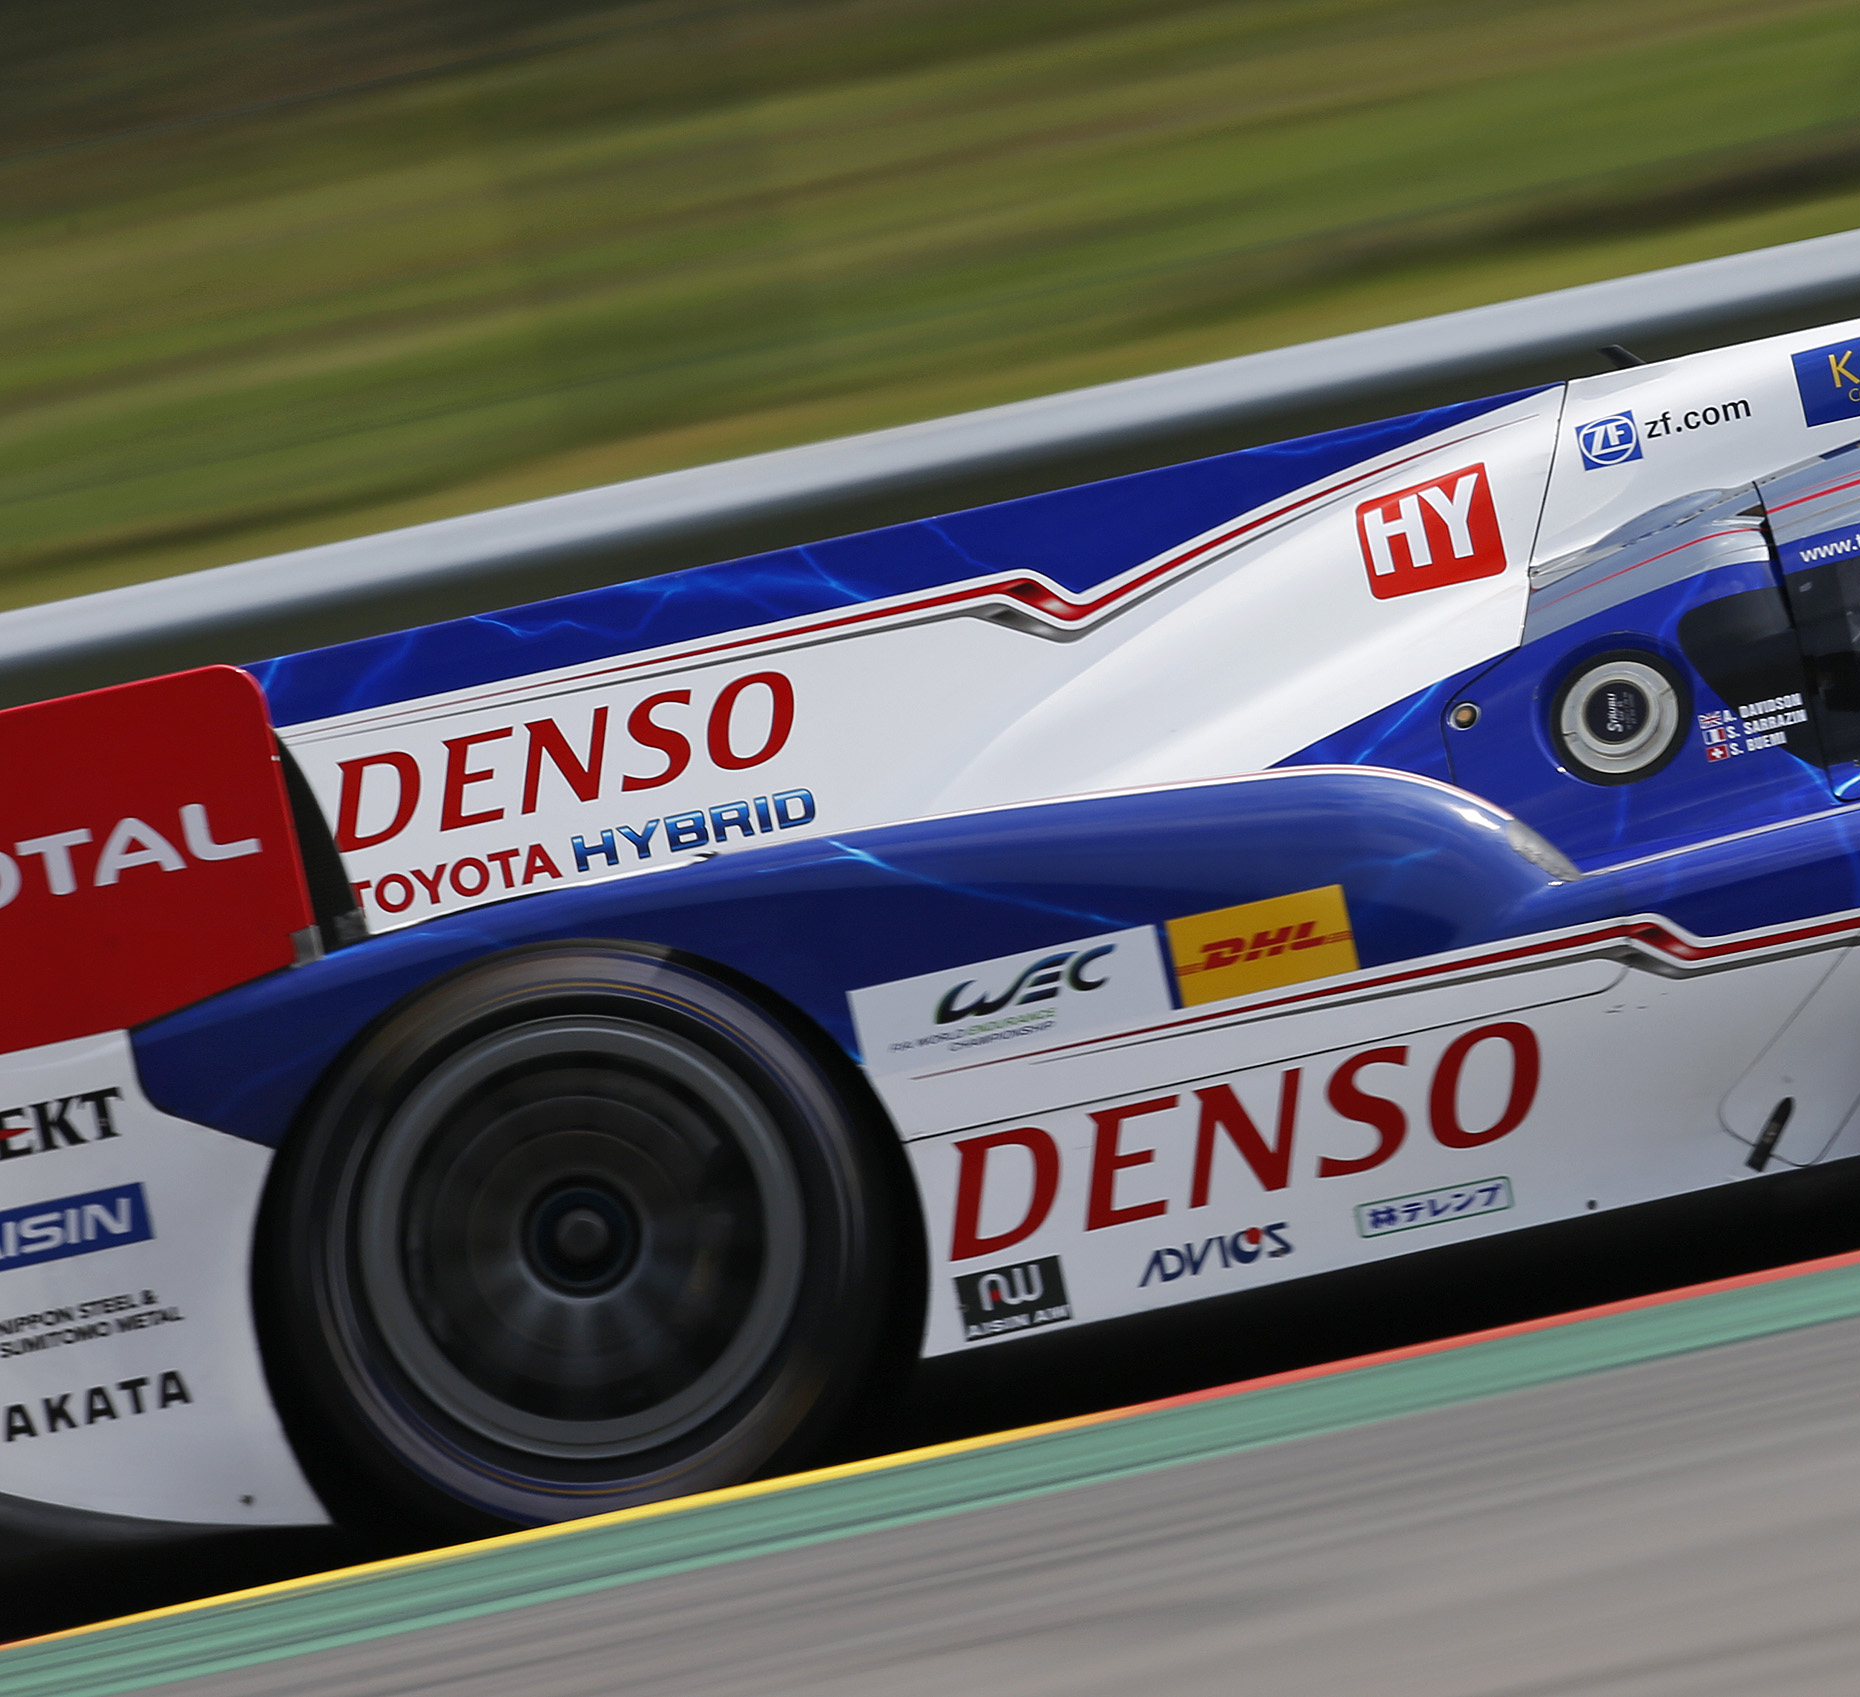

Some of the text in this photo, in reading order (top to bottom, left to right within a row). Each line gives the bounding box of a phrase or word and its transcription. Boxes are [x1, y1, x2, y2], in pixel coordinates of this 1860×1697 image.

[1643, 398, 1753, 440] zf.com
[1362, 472, 1479, 577] HY
[1722, 692, 1804, 723] A. DAVIDSON
[1726, 709, 1808, 739] S. SARRAZIN
[337, 670, 796, 853] DENSO
[1729, 731, 1788, 756] S. BUEMI
[0, 803, 262, 909] TAL
[351, 787, 817, 918] TOYOTA HYBRID
[1200, 920, 1327, 971] DHL
[934, 943, 1117, 1025] WEC
[948, 1020, 1055, 1052] CHAMPIONSHIP
[950, 1020, 1541, 1262] DENSO
[0, 1197, 132, 1260] ISIN
[1137, 1222, 1294, 1288] ADVICS
[0, 1306, 185, 1359] SUMITOMO METAL
[77, 1293, 138, 1318] STEEL
[140, 1289, 158, 1305] &
